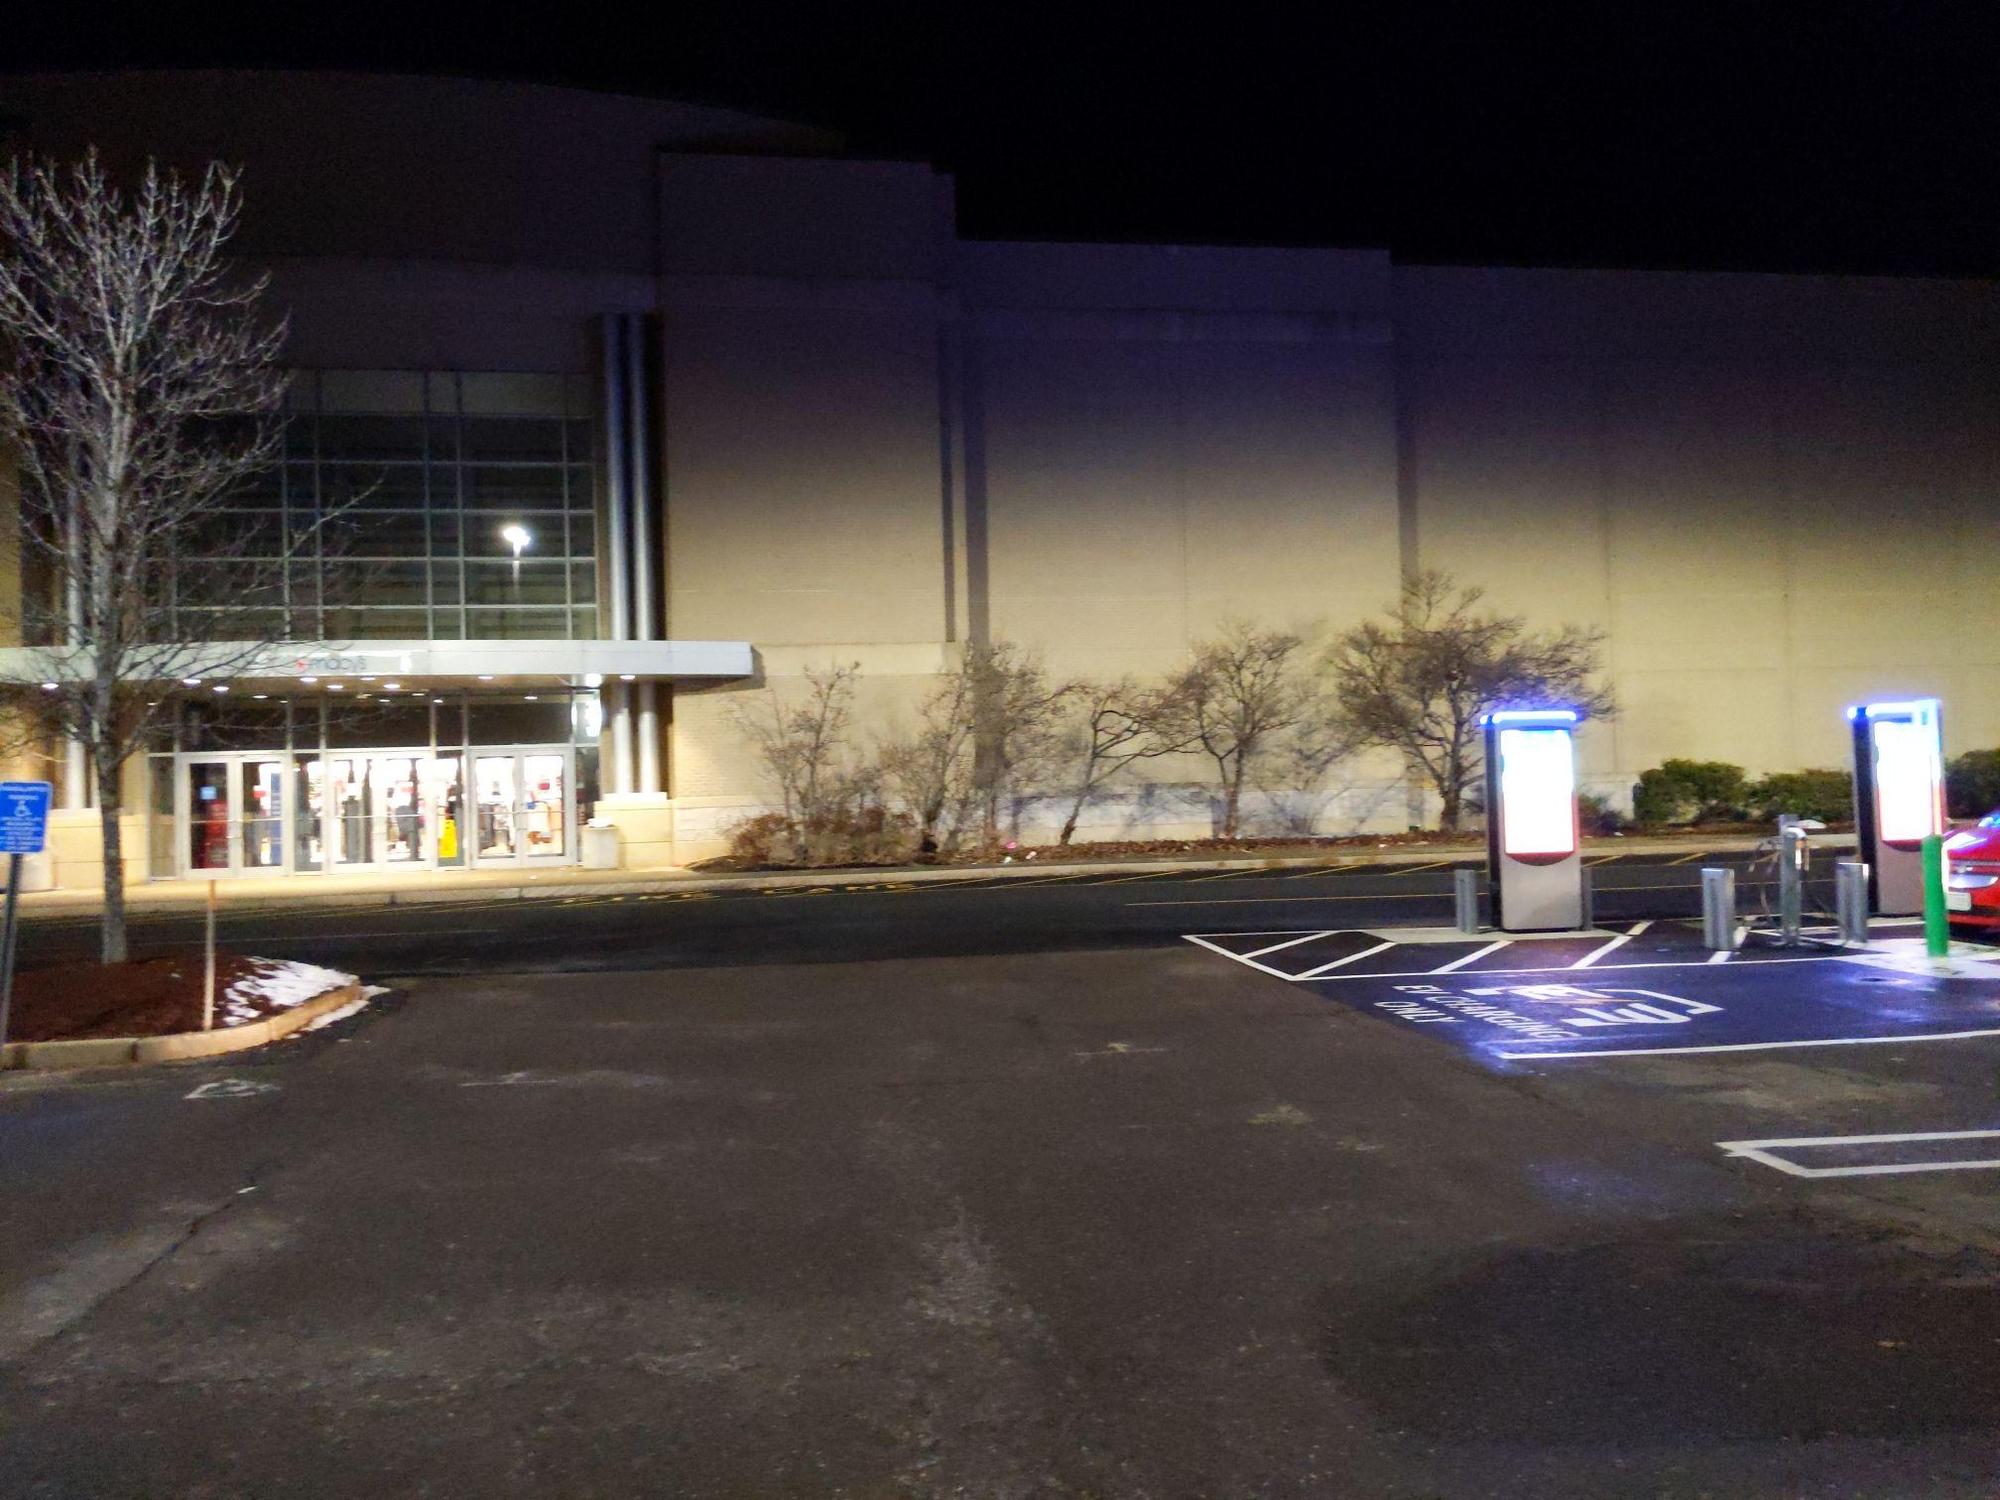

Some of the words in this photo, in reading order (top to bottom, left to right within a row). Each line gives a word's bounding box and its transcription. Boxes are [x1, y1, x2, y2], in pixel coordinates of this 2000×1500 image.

[1374, 1001, 1466, 1022] ONLY
[1392, 985, 1452, 994] EV
[1425, 996, 1582, 1038] CHARGING
